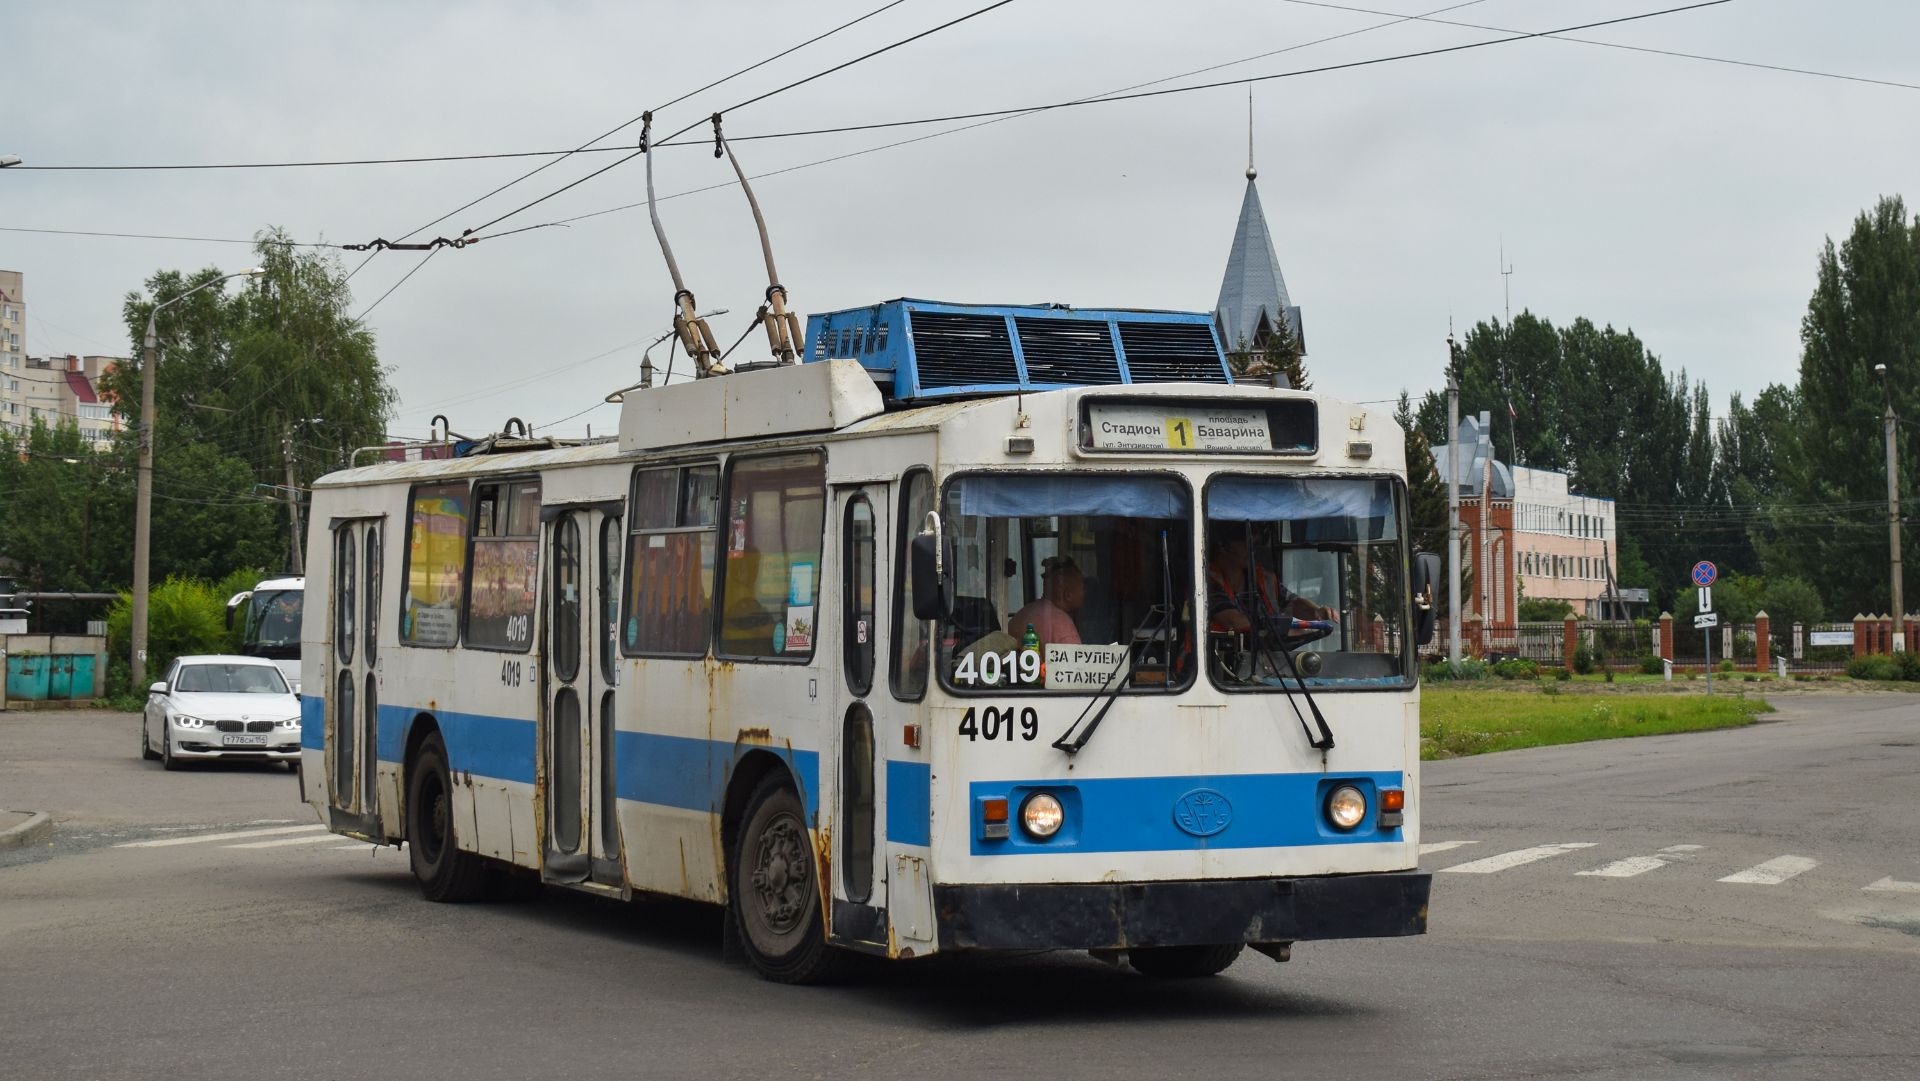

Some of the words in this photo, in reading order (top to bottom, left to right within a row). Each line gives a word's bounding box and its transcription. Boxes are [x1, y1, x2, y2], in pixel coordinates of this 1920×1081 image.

[1101, 421, 1161, 435] Стадион
[1209, 416, 1249, 425] площадь
[1173, 422, 1187, 446] 1
[1198, 425, 1265, 440] Баварина
[506, 615, 528, 642] 4019
[1050, 650, 1069, 663] ЗА
[1074, 650, 1123, 665] РУЛЕМ
[501, 660, 521, 688] 4019
[955, 650, 1041, 685] 4019
[1055, 671, 1117, 685] СТАЖЕР
[958, 706, 1039, 742] 4019
